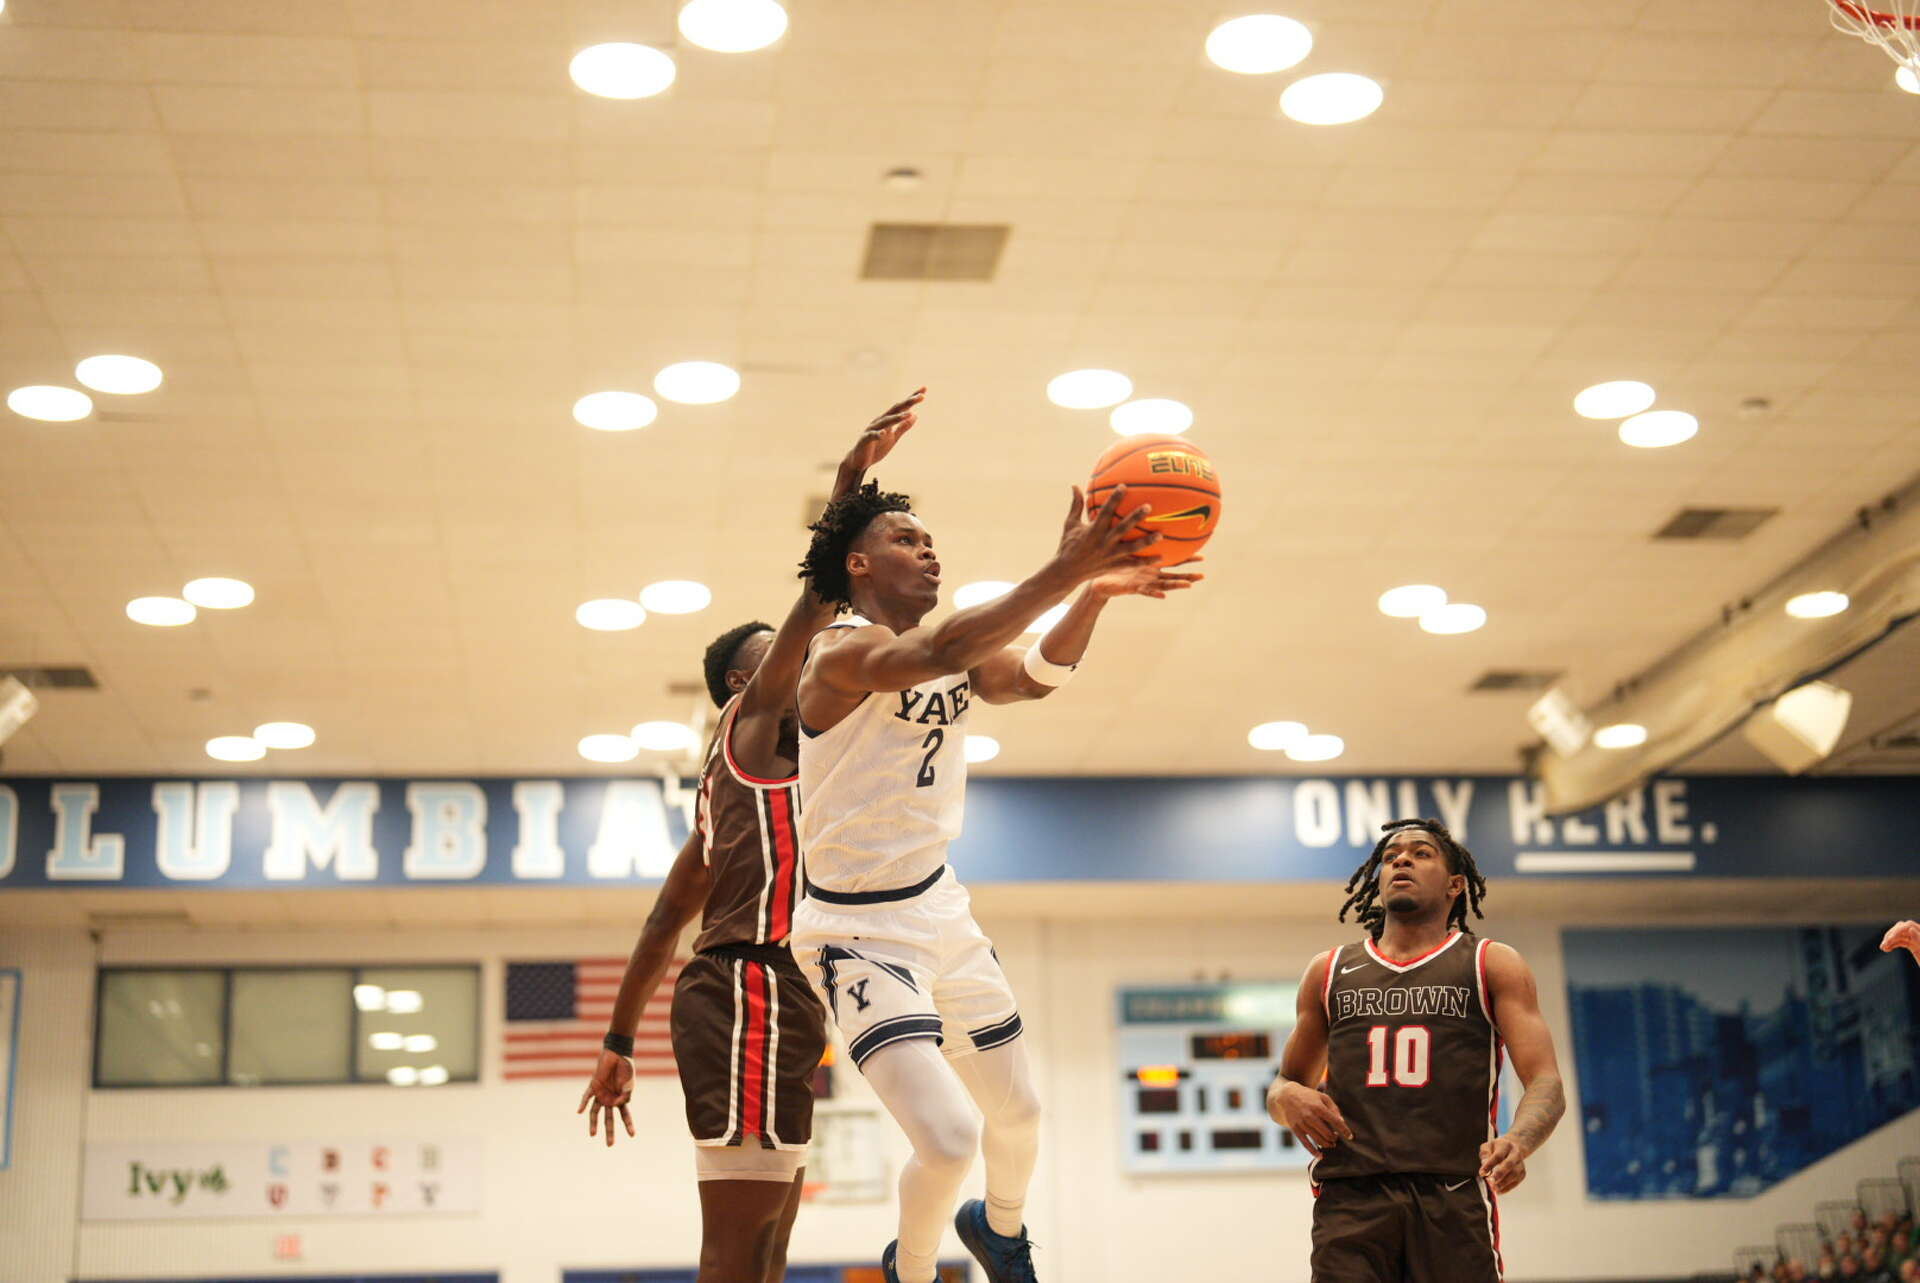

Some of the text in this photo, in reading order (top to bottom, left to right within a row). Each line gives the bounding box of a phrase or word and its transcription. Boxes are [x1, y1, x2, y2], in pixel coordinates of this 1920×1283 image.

[1149, 454, 1215, 482] ELITE
[894, 682, 968, 726] YAE
[916, 728, 944, 788] 2
[0, 782, 685, 881] LUMBIA
[847, 976, 871, 1013] Y
[1336, 986, 1471, 1020] BROWN
[1365, 1025, 1431, 1088] 10
